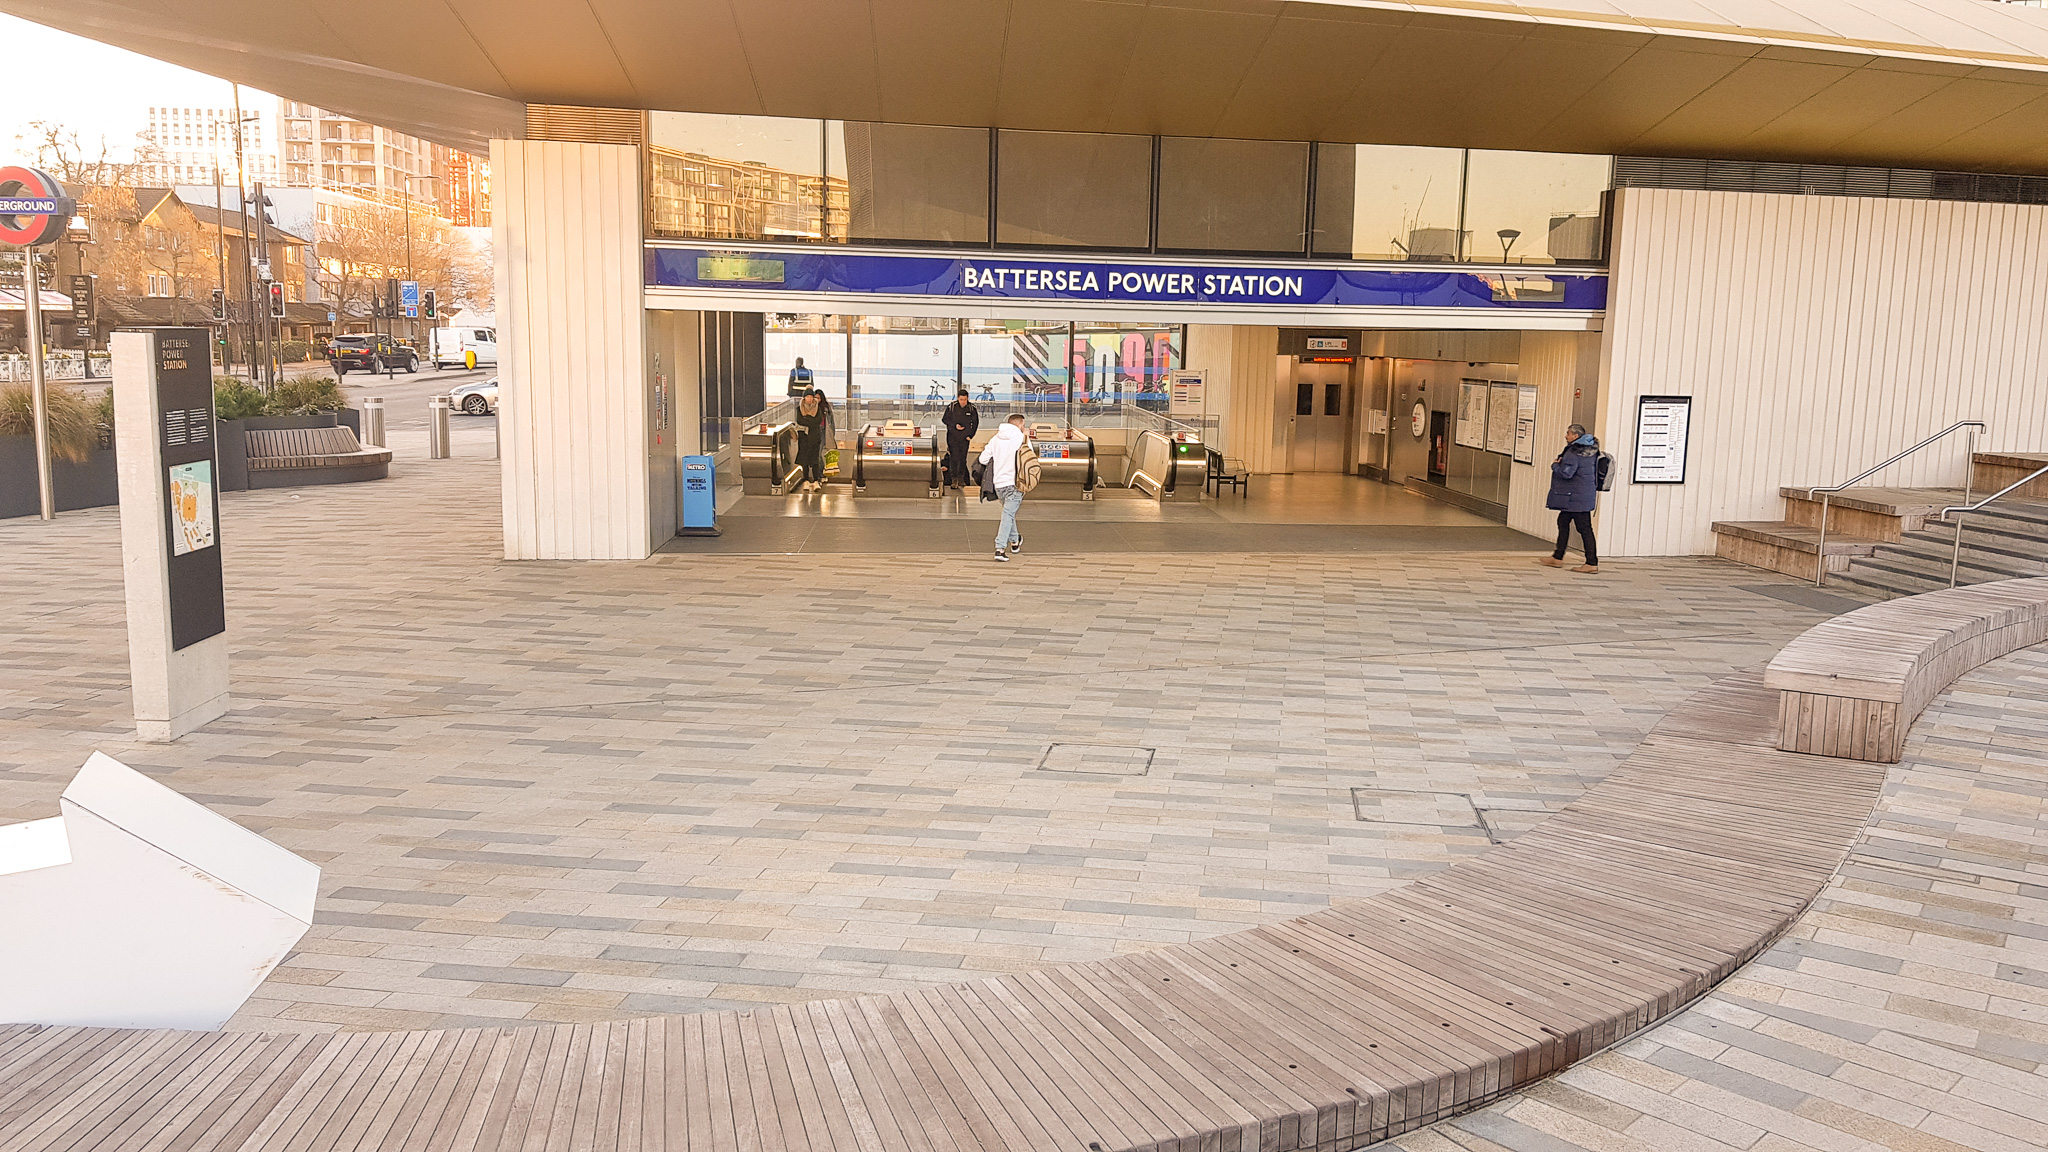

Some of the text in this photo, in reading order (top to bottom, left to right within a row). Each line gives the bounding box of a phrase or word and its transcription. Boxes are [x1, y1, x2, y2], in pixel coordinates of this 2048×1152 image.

[964, 267, 1303, 296] BATTERSEA POWER STATION
[162, 339, 190, 348] BATTERSE
[162, 350, 184, 359] POWER
[163, 360, 188, 370] STATION
